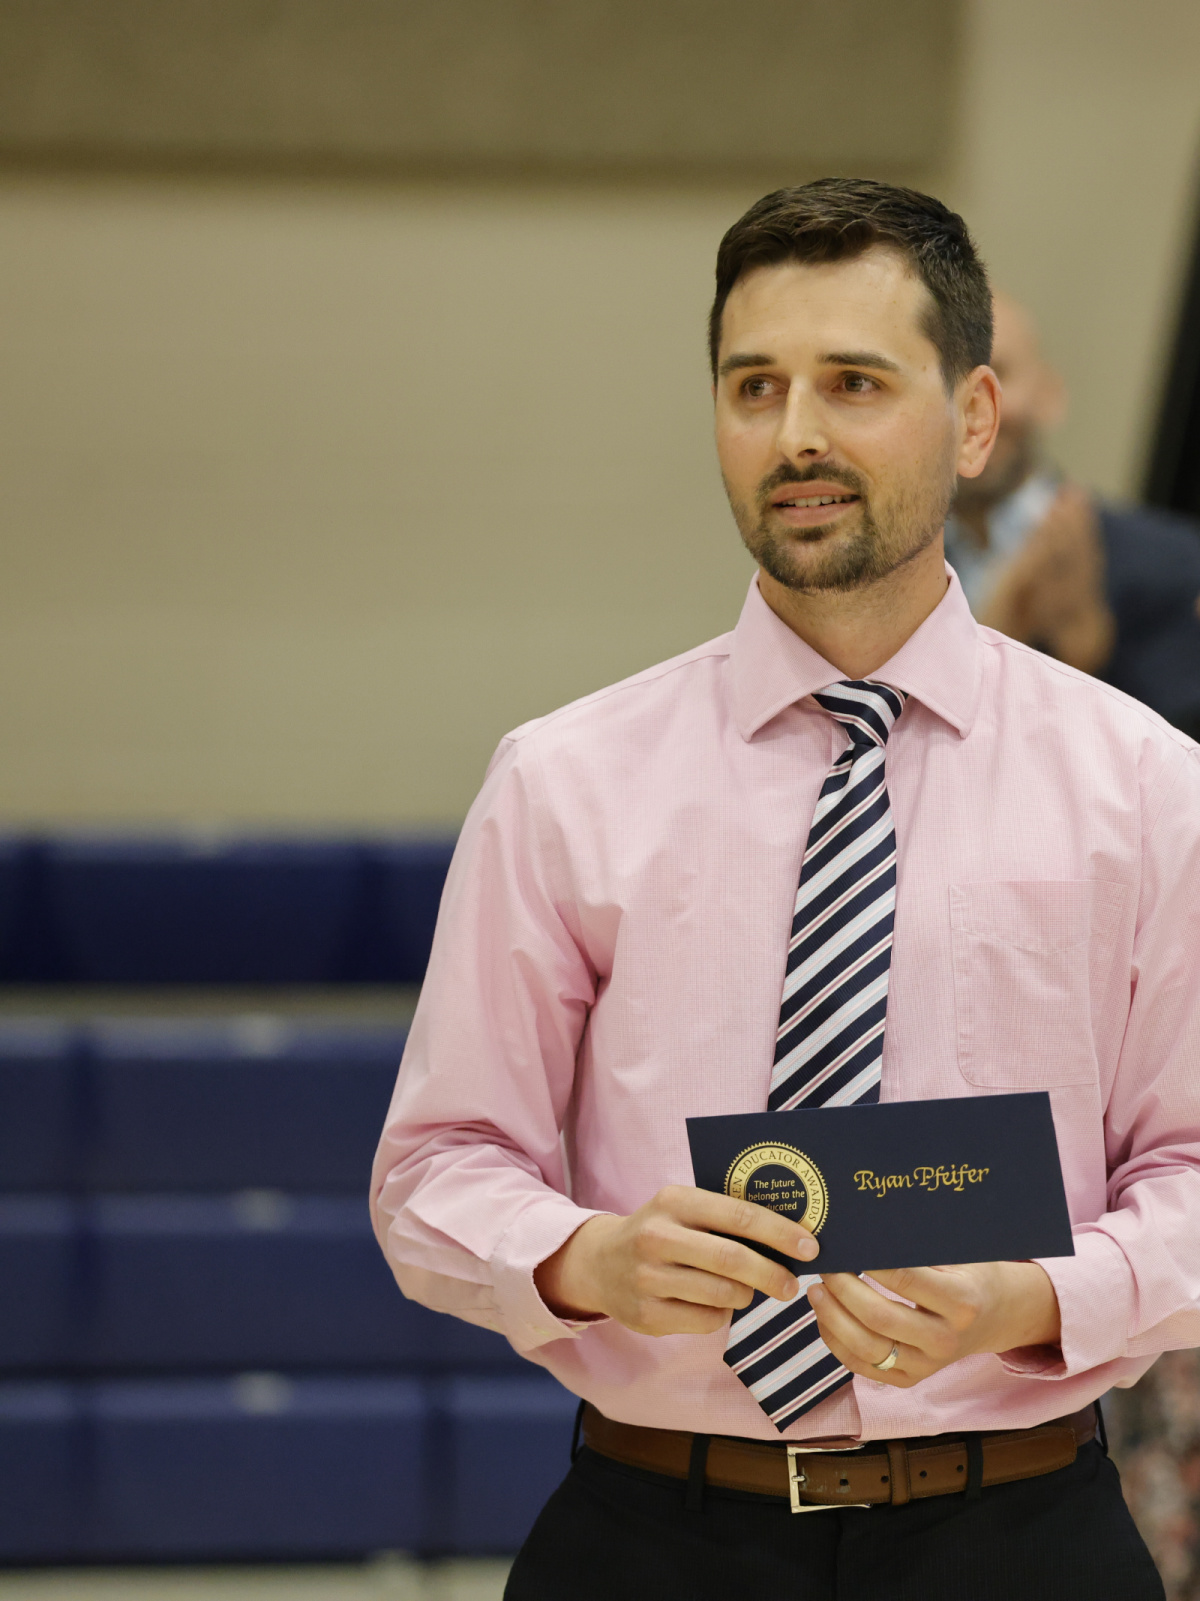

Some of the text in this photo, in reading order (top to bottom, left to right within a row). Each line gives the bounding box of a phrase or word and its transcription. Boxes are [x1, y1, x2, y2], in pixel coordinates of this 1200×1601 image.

[738, 1150, 801, 1175] EDUCATOR
[801, 1169, 821, 1222] AWARDS
[753, 1178, 796, 1191] The future
[853, 1163, 990, 1198] Ryan Pfeifer
[748, 1189, 806, 1202] belongs to the
[765, 1201, 798, 1212] ducated
